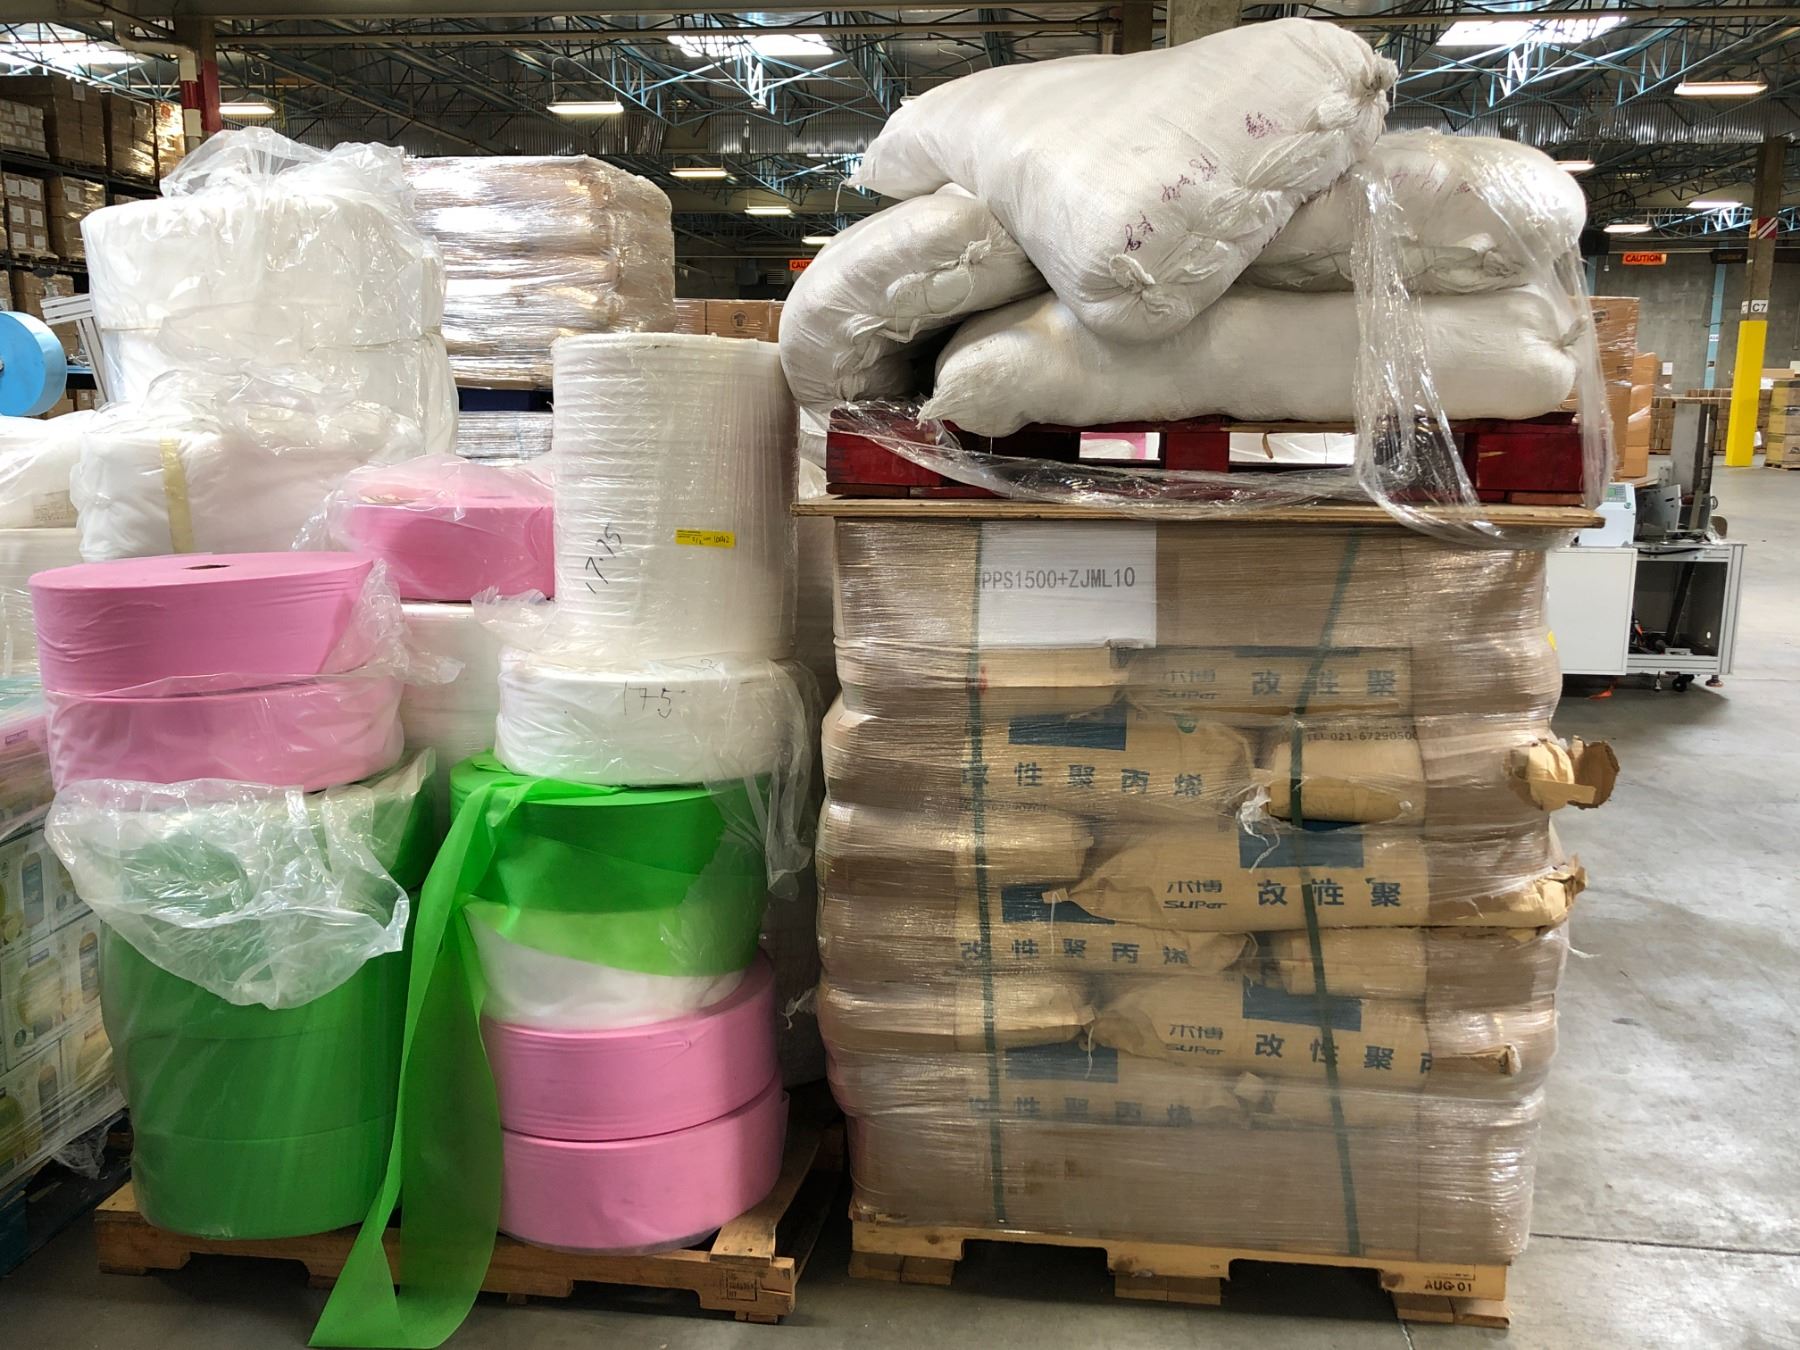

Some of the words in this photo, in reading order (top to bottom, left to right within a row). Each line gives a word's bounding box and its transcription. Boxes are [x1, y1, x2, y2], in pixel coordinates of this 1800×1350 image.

[1625, 253, 1662, 263] CAUTION
[1752, 303, 1767, 312] C7
[982, 567, 1136, 589] PPS1500+ZJML10
